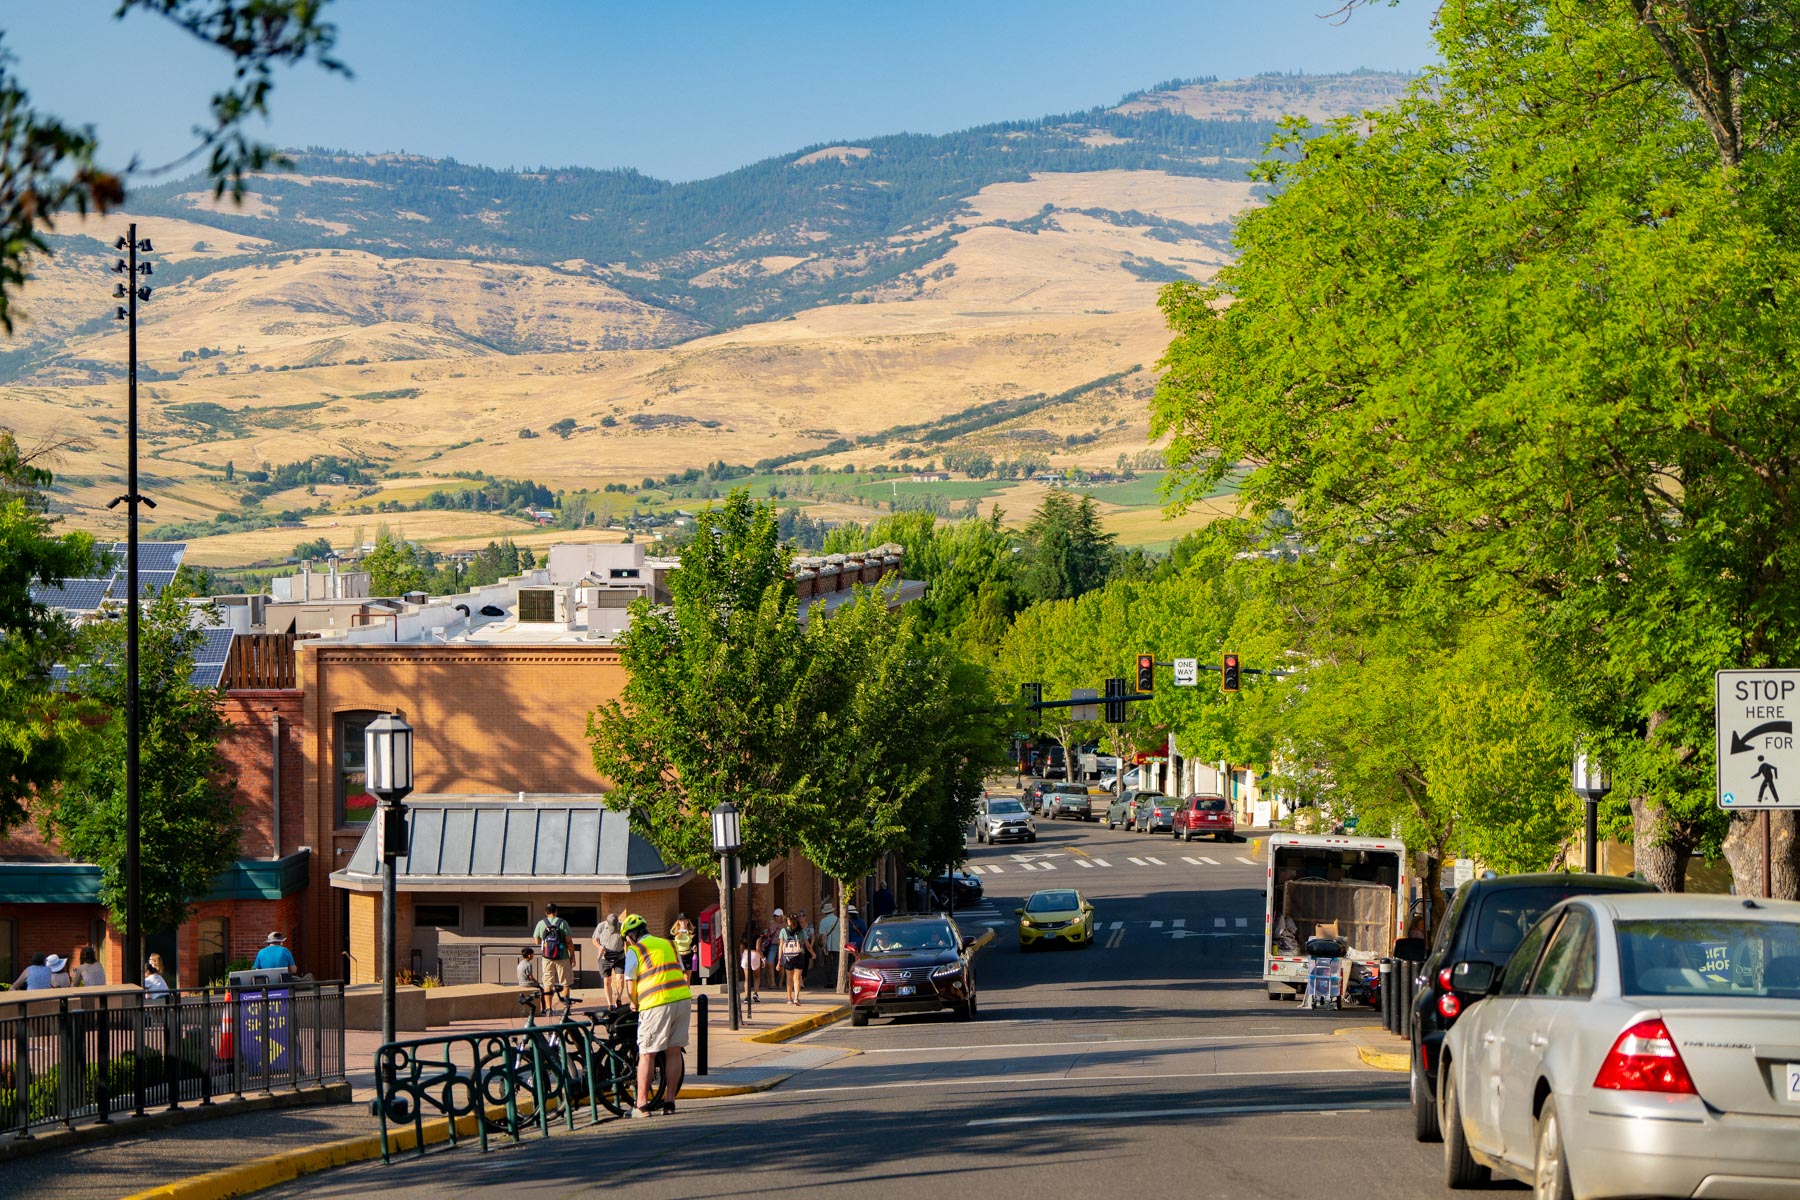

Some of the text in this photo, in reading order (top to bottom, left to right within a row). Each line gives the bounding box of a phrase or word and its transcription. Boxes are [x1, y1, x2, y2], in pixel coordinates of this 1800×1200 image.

[1735, 680, 1795, 701] STOP
[1746, 706, 1785, 718] HERE
[1765, 737, 1793, 749] FOR
